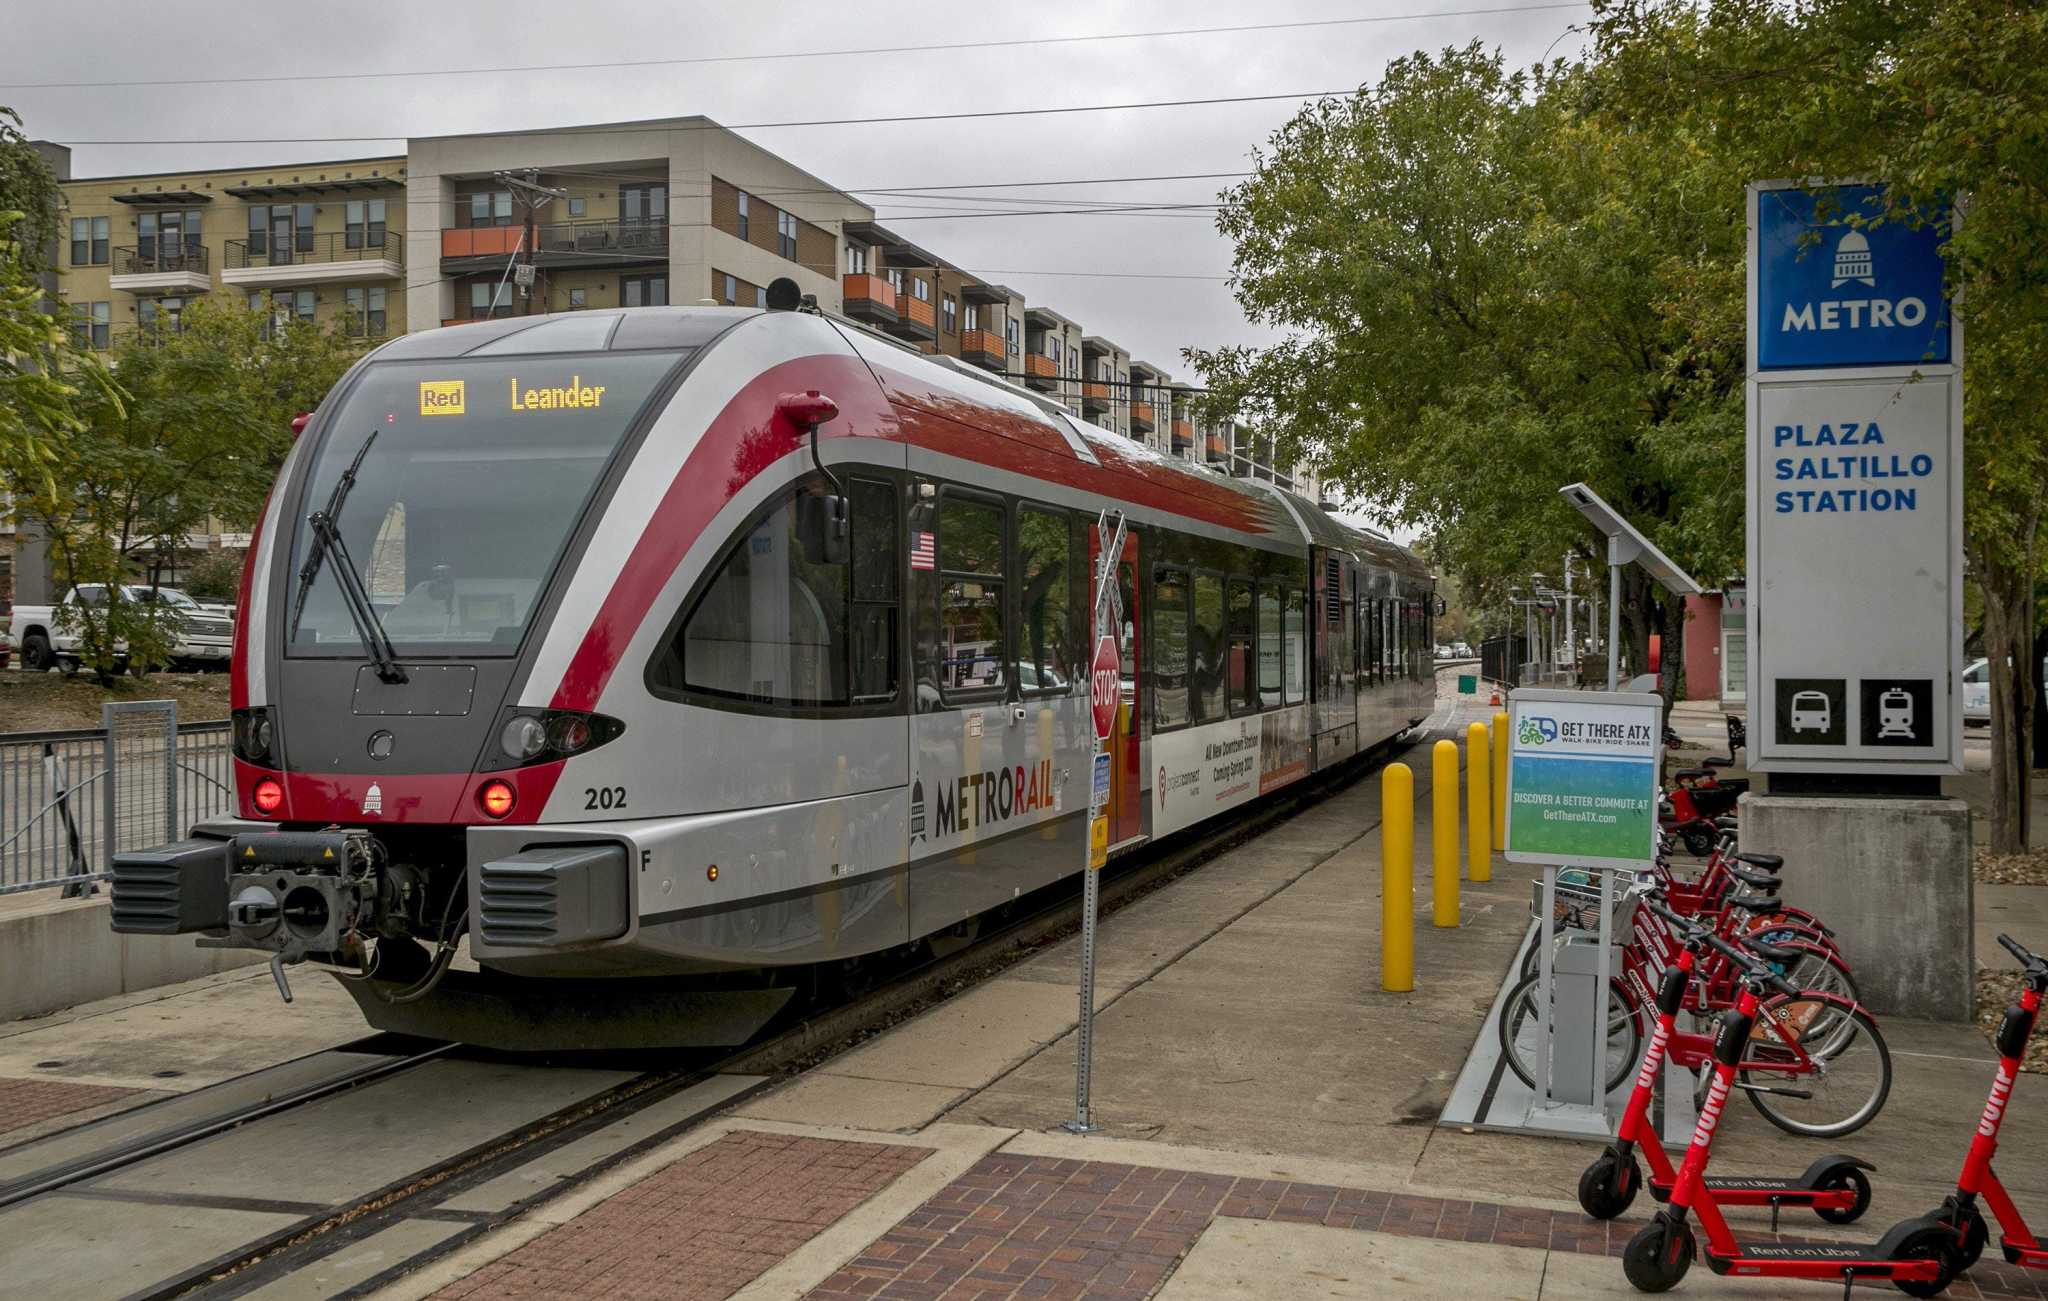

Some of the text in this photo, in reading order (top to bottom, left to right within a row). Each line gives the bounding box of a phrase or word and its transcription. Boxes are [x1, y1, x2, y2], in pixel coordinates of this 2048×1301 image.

[1781, 297, 1927, 332] METRO
[424, 389, 461, 407] Red
[511, 375, 605, 410] Leander
[1774, 422, 1885, 447] PLAZA
[1775, 454, 1933, 480] SALTILLO
[1775, 488, 1917, 513] STATION
[1093, 669, 1117, 706] STOP
[1562, 722, 1651, 740] GET THERE ATX
[584, 786, 627, 810] 202
[935, 759, 1055, 838] METRORAIL
[1514, 792, 1649, 810] DISCOVER A BETTER COMMUTE AT
[1543, 809, 1617, 824] GetThereATX.com
[641, 850, 651, 872] F
[1638, 1021, 1670, 1088] JUMP
[1693, 1071, 1730, 1147] JUMP
[1978, 1065, 2012, 1136] JUMP
[1747, 1180, 1787, 1188] Uber
[1749, 1246, 1861, 1257] Rent on Uber
